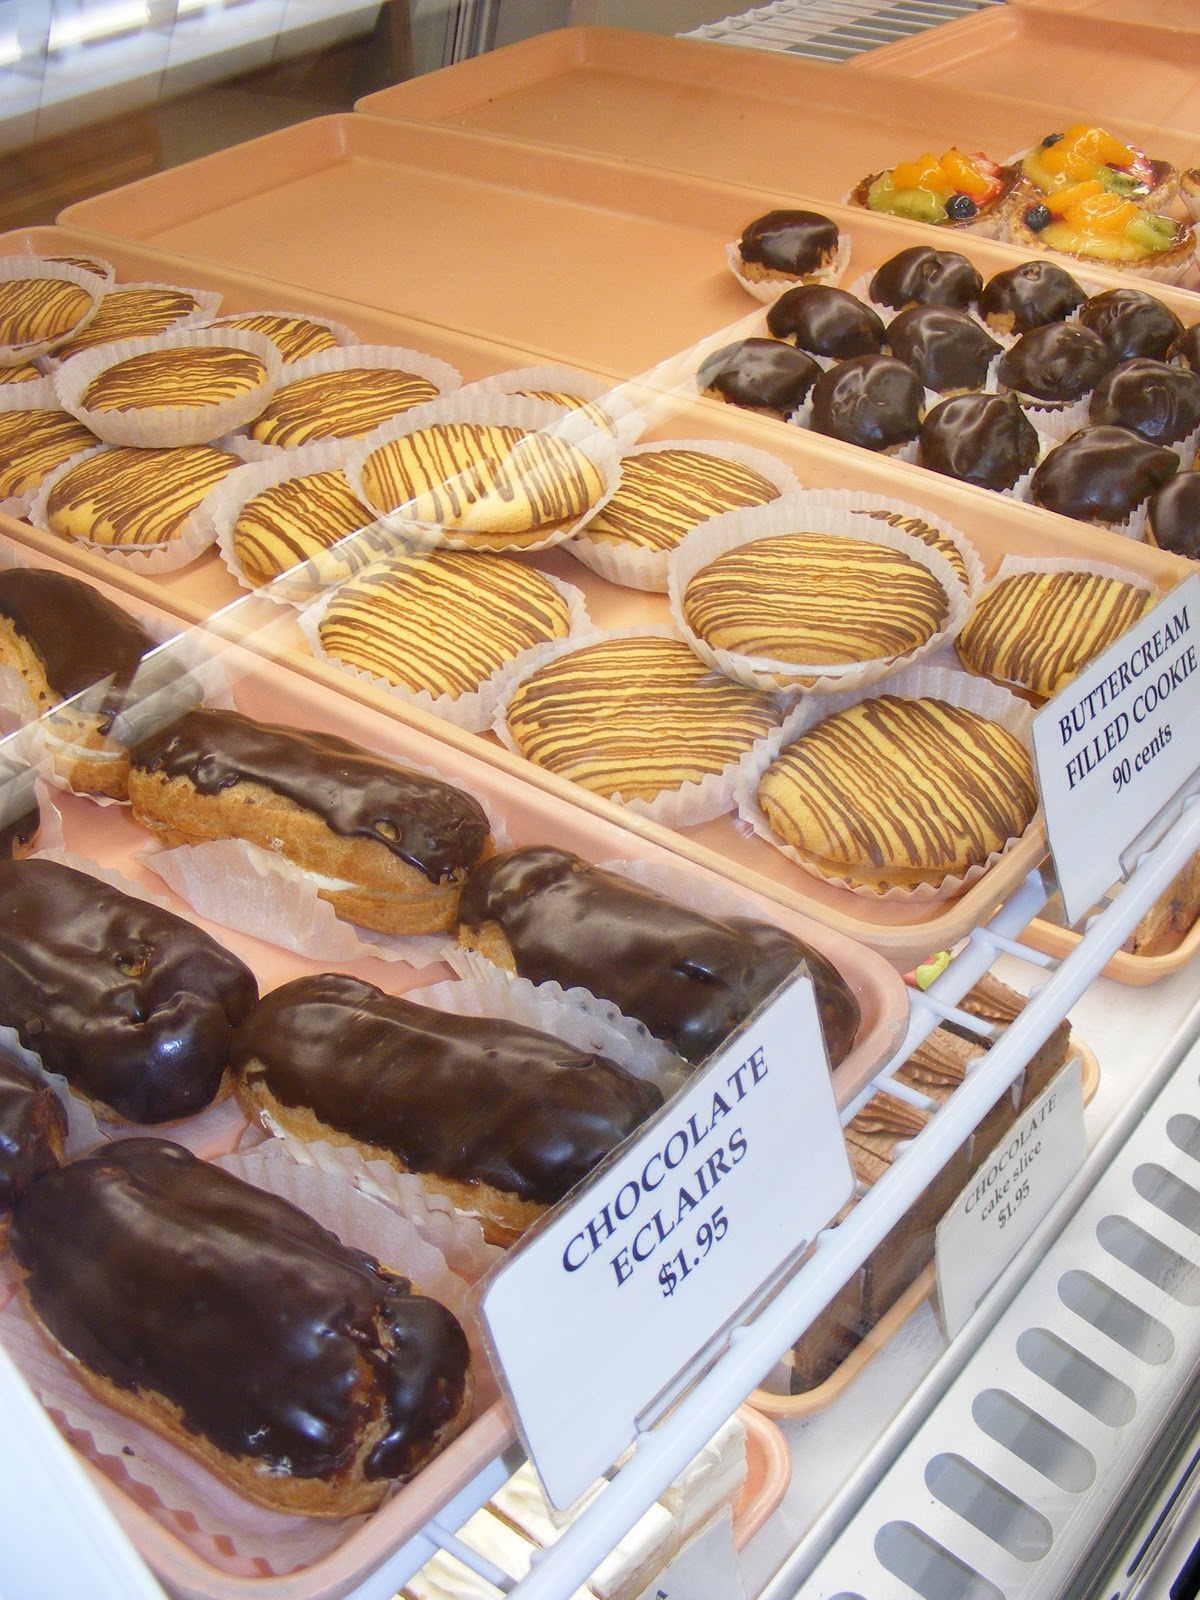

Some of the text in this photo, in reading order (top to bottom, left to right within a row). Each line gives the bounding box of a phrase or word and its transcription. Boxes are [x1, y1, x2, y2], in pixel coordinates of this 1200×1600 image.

[1058, 605, 1191, 746] BUTTERCREAM
[1065, 645, 1198, 790] FILLED COOKIE
[1112, 723, 1173, 793] 90 cents
[561, 1045, 769, 1273] CHOCOLATE
[609, 1128, 748, 1288] ECLAIRS
[964, 1093, 1057, 1214] CHOCOLATE
[981, 1141, 1042, 1221] cake slice
[998, 1179, 1030, 1229] $1.95
[657, 1206, 729, 1298] $1.95
